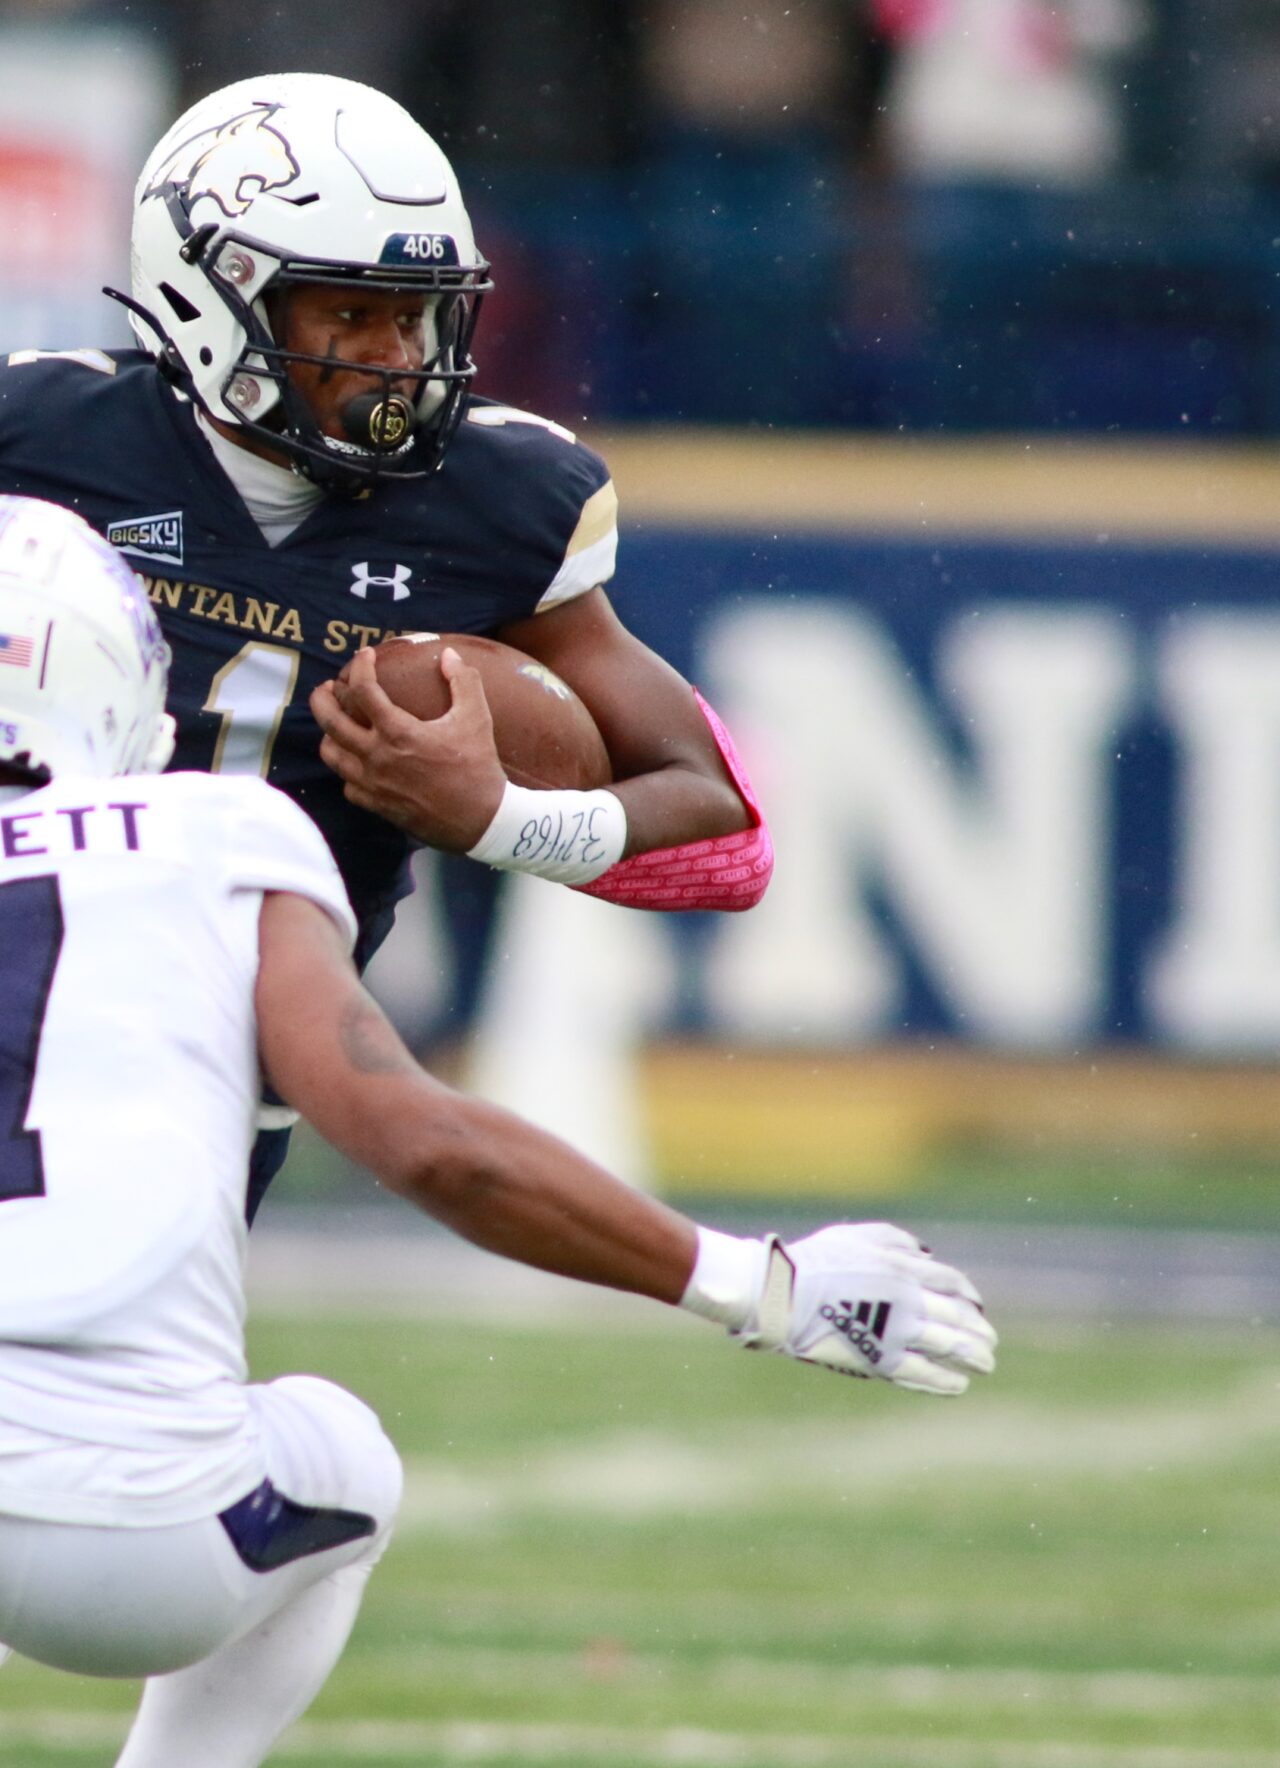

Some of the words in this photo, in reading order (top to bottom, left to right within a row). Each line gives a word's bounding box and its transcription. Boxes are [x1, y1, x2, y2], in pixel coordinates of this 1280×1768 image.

[403, 235, 444, 259] 406
[144, 577, 305, 642] NTANA
[202, 641, 301, 778] 1
